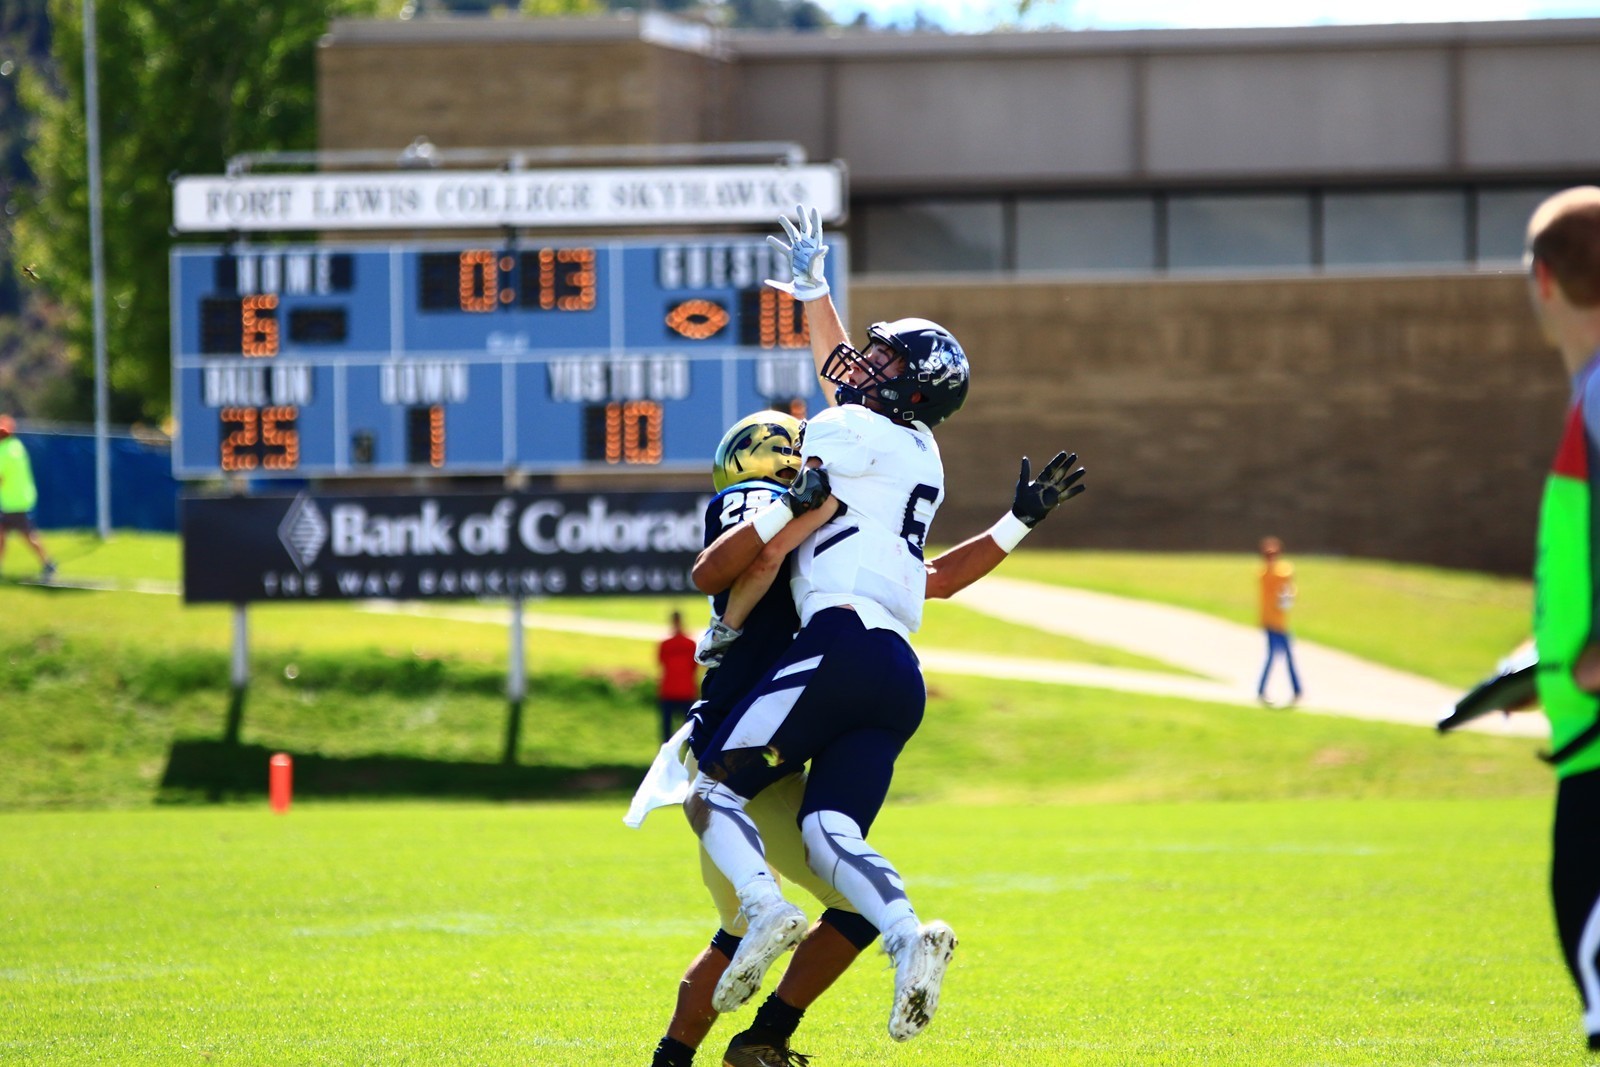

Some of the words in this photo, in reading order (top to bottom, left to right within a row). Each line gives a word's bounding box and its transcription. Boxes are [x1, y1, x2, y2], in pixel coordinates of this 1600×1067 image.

[206, 185, 292, 220] FORT
[312, 182, 419, 218] LEWIS
[436, 177, 592, 217] COLLEGE
[609, 173, 811, 211] SKYHAWKS
[237, 249, 331, 296] HOME
[241, 294, 279, 357] 6
[220, 406, 299, 471] 25
[605, 400, 663, 464] 10
[331, 500, 455, 557] Bank
[458, 499, 516, 555] of
[518, 497, 706, 554] Colorad
[579, 565, 694, 592] SHOUL
